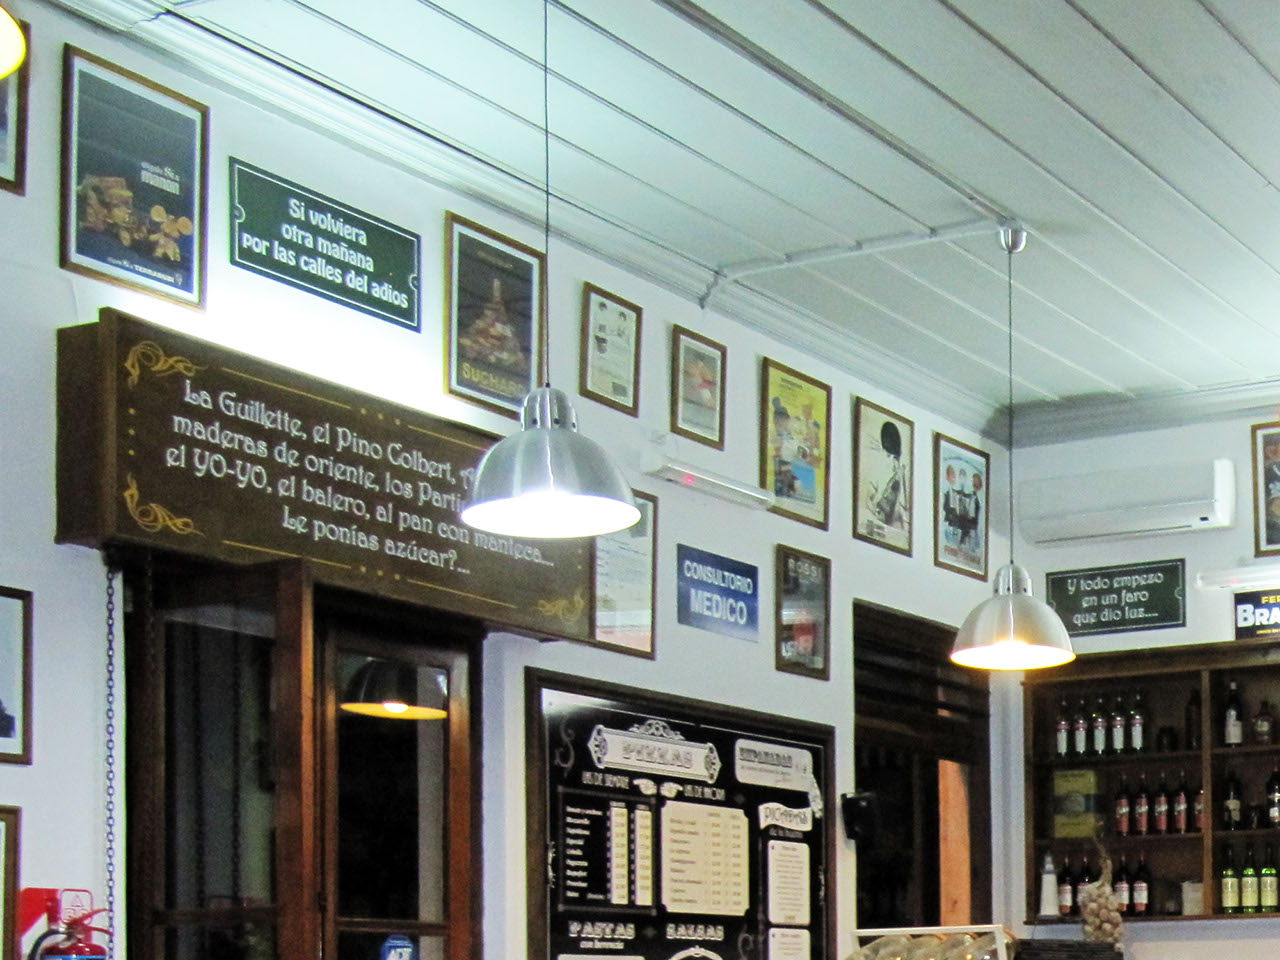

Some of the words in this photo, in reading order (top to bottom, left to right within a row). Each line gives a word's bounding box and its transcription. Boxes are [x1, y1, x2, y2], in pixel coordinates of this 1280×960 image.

[288, 198, 306, 221] Si
[308, 209, 367, 246] volviera
[241, 232, 270, 255] por
[272, 240, 297, 266] las
[299, 254, 343, 284] calles
[345, 270, 368, 293] del
[370, 282, 409, 308] adios
[281, 223, 314, 248] otra
[316, 236, 374, 272] mañana
[184, 378, 213, 410] La
[218, 391, 307, 441] Guillette,
[312, 422, 330, 444] el
[335, 426, 383, 460] Pino
[387, 442, 456, 485] Colbert,
[172, 415, 268, 458] maderas
[273, 441, 300, 468] de
[304, 454, 380, 492] oriente,
[384, 471, 413, 499] los
[417, 481, 464, 513] Parti
[165, 444, 186, 468] el
[277, 475, 296, 498] el
[302, 479, 371, 520] balero,
[375, 502, 393, 523] al
[398, 510, 433, 532] pan
[437, 521, 470, 544] con
[282, 505, 309, 534] Le
[312, 524, 380, 551] ponías
[683, 559, 753, 595] CONSULTORIO
[1080, 576, 1110, 590] todo
[1113, 572, 1164, 588] empezo
[1082, 595, 1098, 608] en
[1101, 594, 1118, 605] un
[1121, 590, 1149, 606] faro
[689, 588, 748, 625] MEDICO
[1073, 612, 1097, 626] que
[1100, 608, 1122, 622] dio
[568, 920, 635, 940] PASTAS
